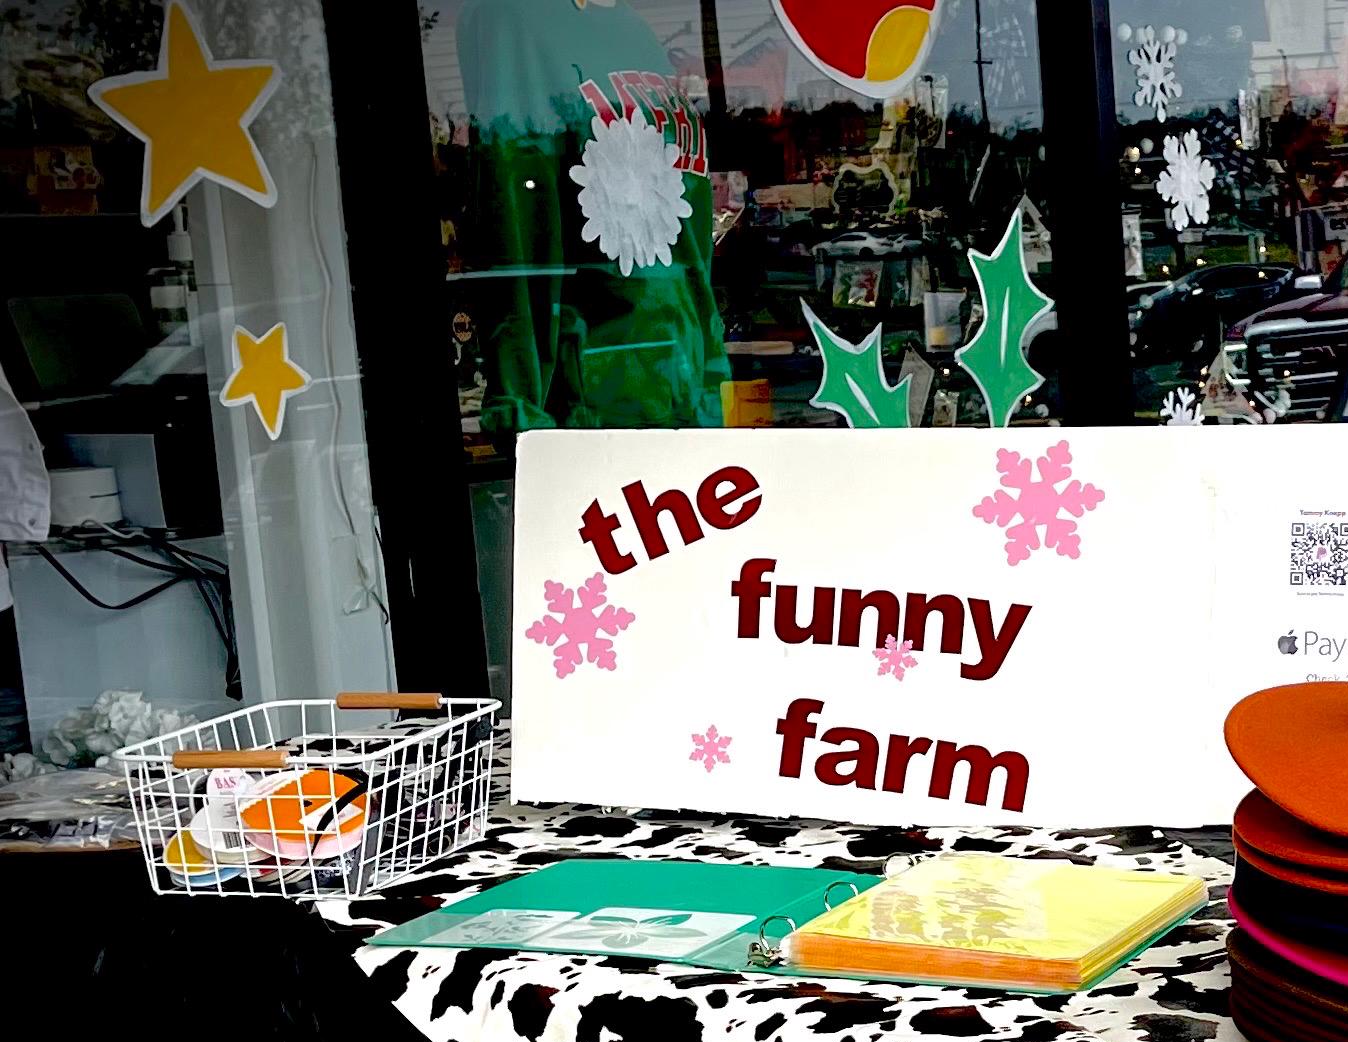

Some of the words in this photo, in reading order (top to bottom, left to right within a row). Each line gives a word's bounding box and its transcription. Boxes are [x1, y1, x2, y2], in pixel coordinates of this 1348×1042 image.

[579, 466, 763, 575] the
[731, 558, 1033, 681] funny
[1304, 631, 1347, 662] Pay
[775, 698, 1030, 813] farm
